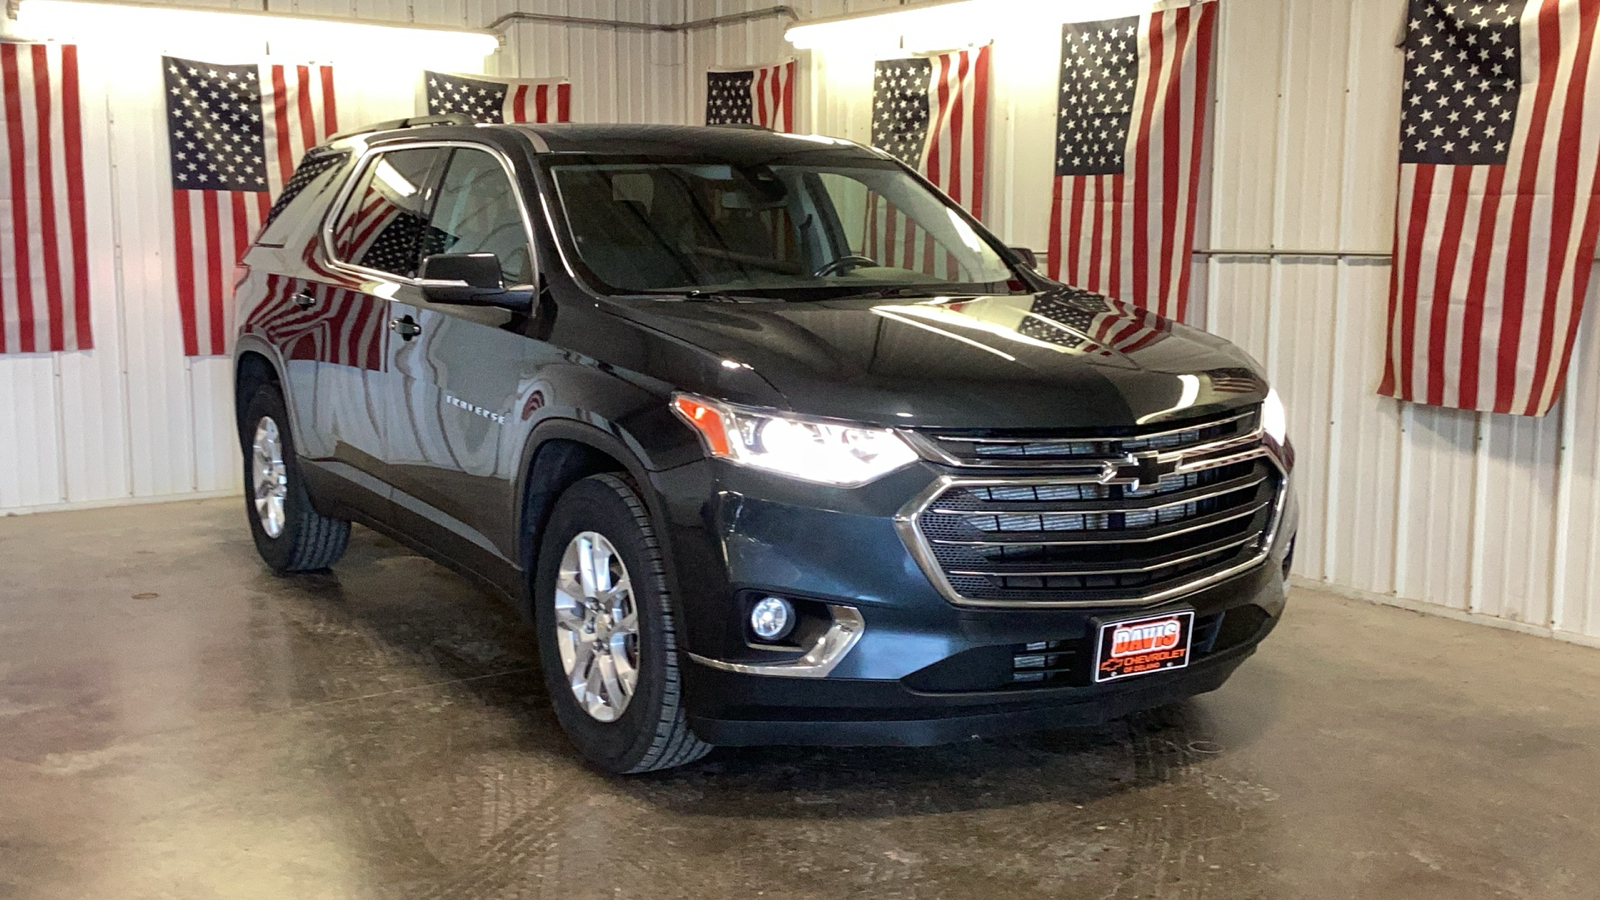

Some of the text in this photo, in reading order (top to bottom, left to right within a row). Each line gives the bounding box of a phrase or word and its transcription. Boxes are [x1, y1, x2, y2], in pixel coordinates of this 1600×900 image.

[446, 395, 505, 425] TRAVERSE
[1113, 622, 1178, 655] DAVIS
[1123, 648, 1186, 666] CHEVROLET
